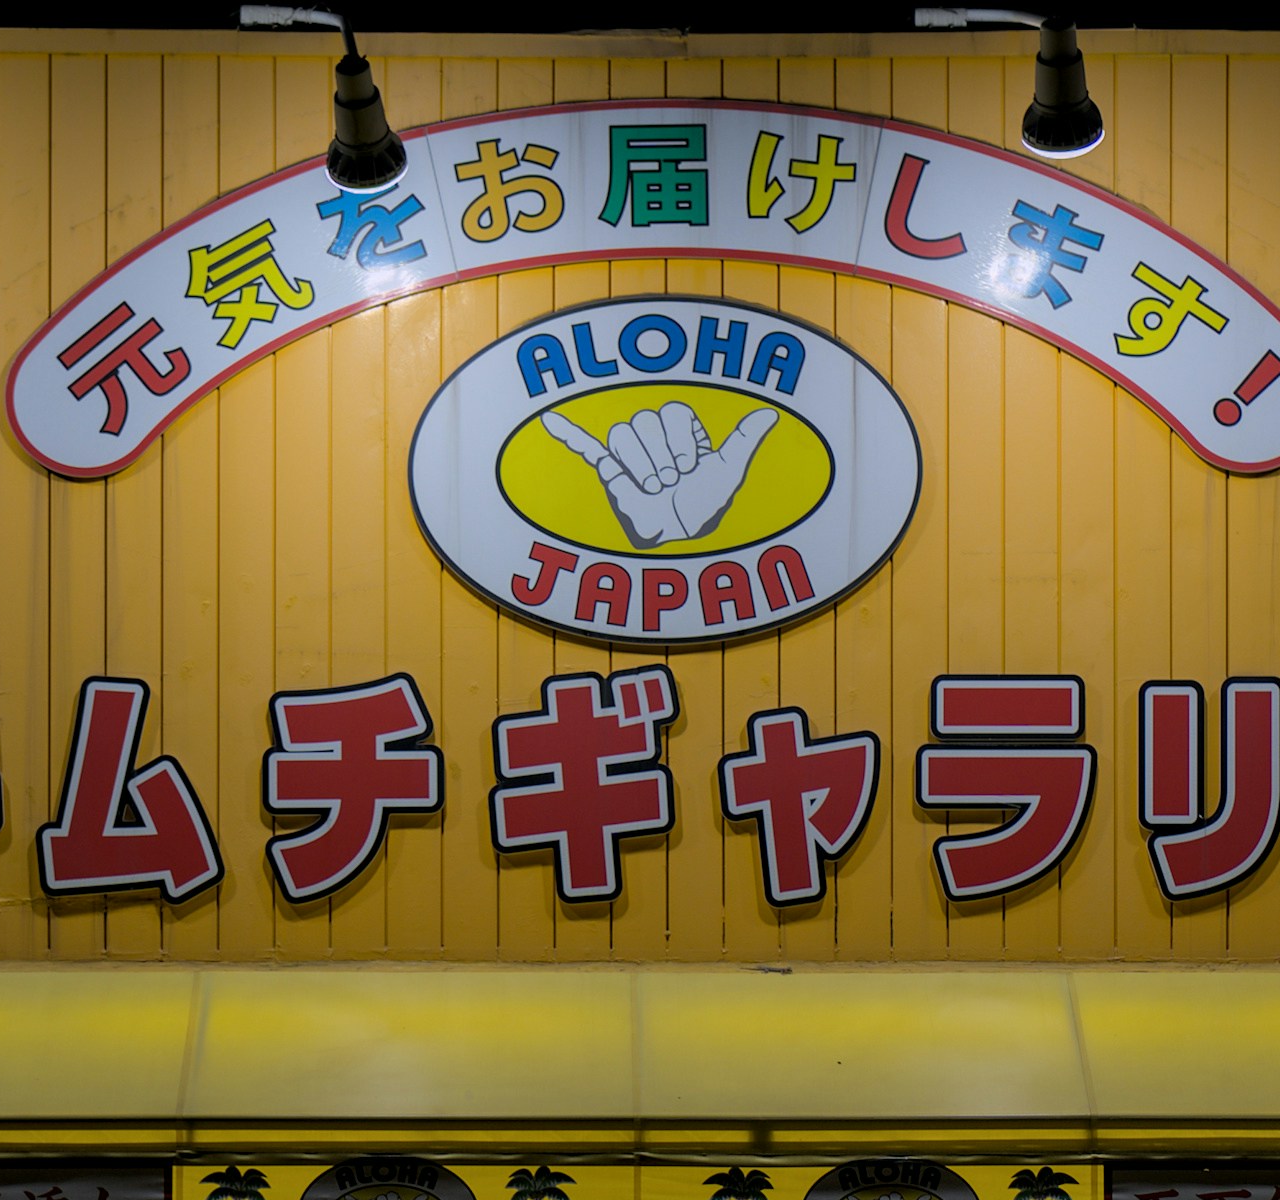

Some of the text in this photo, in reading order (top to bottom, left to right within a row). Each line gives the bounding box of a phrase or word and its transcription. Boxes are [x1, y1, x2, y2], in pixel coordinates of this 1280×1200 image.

[517, 313, 806, 398] ALOHA
[511, 541, 815, 632] JAPAN
[335, 1160, 439, 1190] ALOHA
[838, 1161, 942, 1191] ALOHA
